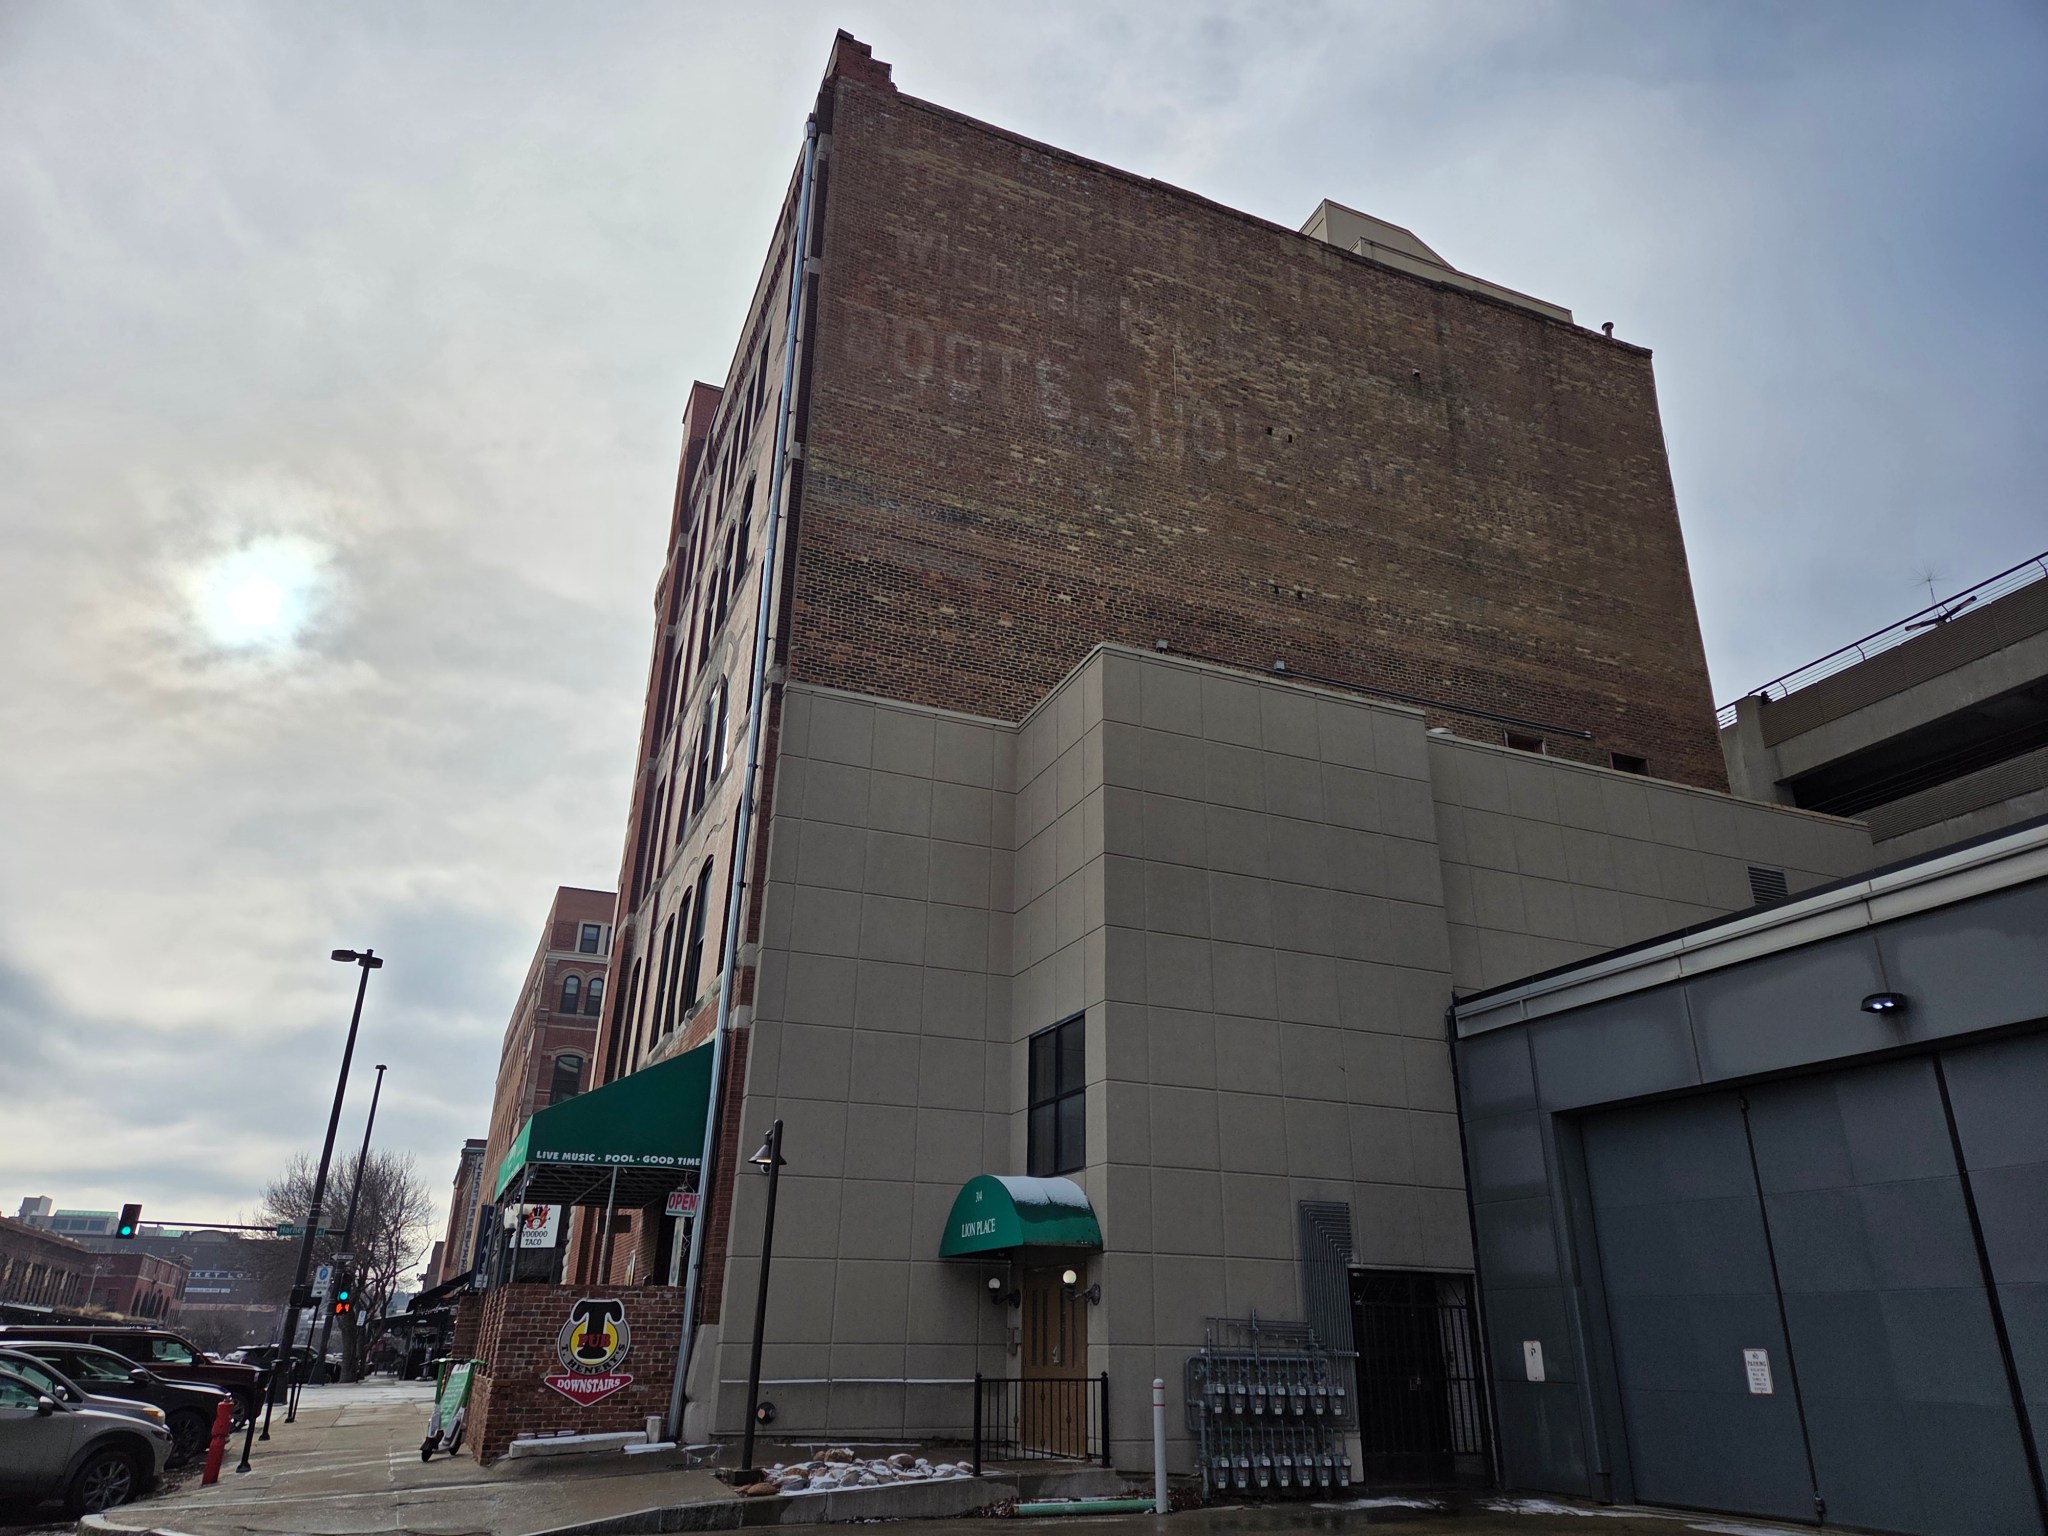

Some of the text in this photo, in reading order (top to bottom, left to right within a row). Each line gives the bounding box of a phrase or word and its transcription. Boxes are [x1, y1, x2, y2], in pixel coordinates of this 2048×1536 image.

[536, 1150, 559, 1160] LIVE
[562, 1152, 595, 1162] MUSIC
[604, 1154, 634, 1163] POOL
[642, 1155, 674, 1165] GOOD
[668, 1193, 697, 1211] OPEN
[961, 1218, 996, 1238] LION PLACE
[525, 1238, 542, 1246] TACO
[577, 1333, 612, 1348] PUB
[556, 1378, 621, 1394] DOWNSTAIRS
